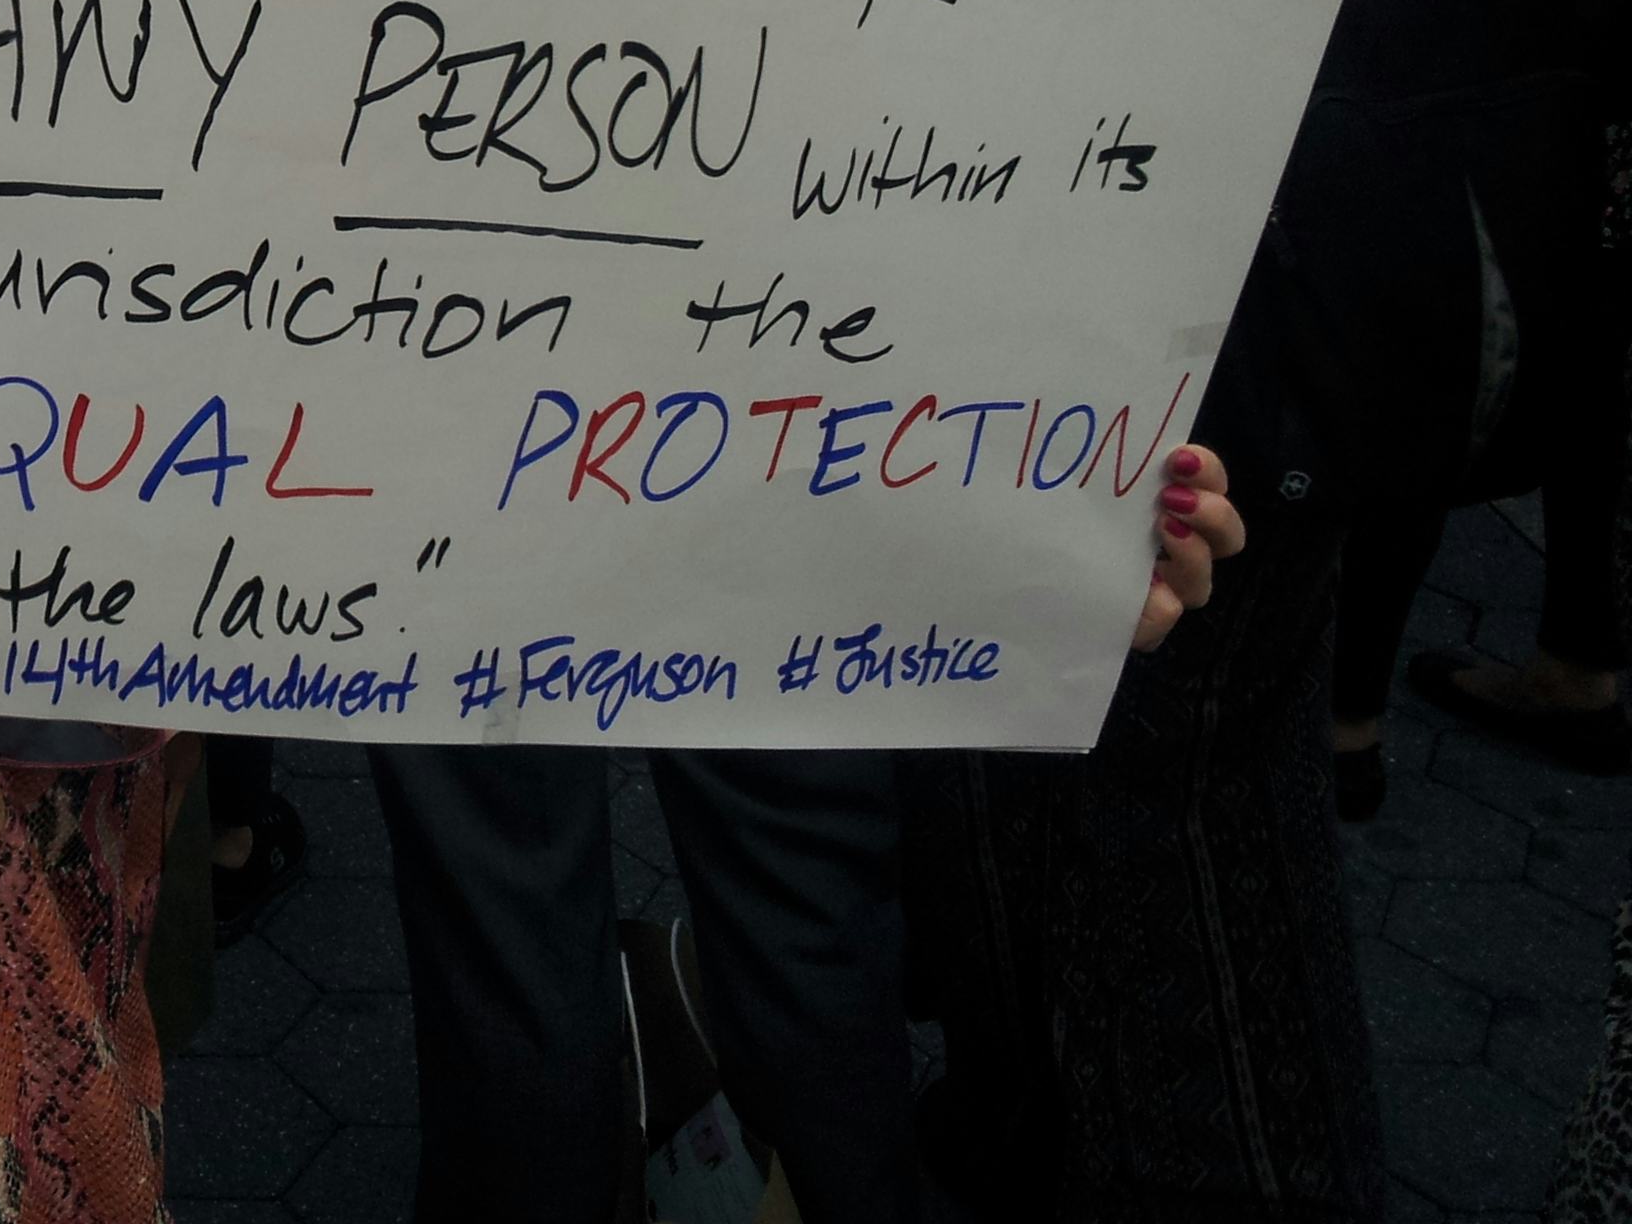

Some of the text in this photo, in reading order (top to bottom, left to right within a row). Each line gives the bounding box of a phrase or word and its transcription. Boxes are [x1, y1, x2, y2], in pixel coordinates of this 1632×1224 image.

[341, 1, 767, 193] PERSON
[793, 116, 1021, 220] within
[1070, 113, 1157, 192] its
[686, 272, 894, 363] the
[498, 372, 1190, 511] PROTECTION
[454, 636, 736, 731] #Ferguson
[777, 623, 999, 694] #Justice
